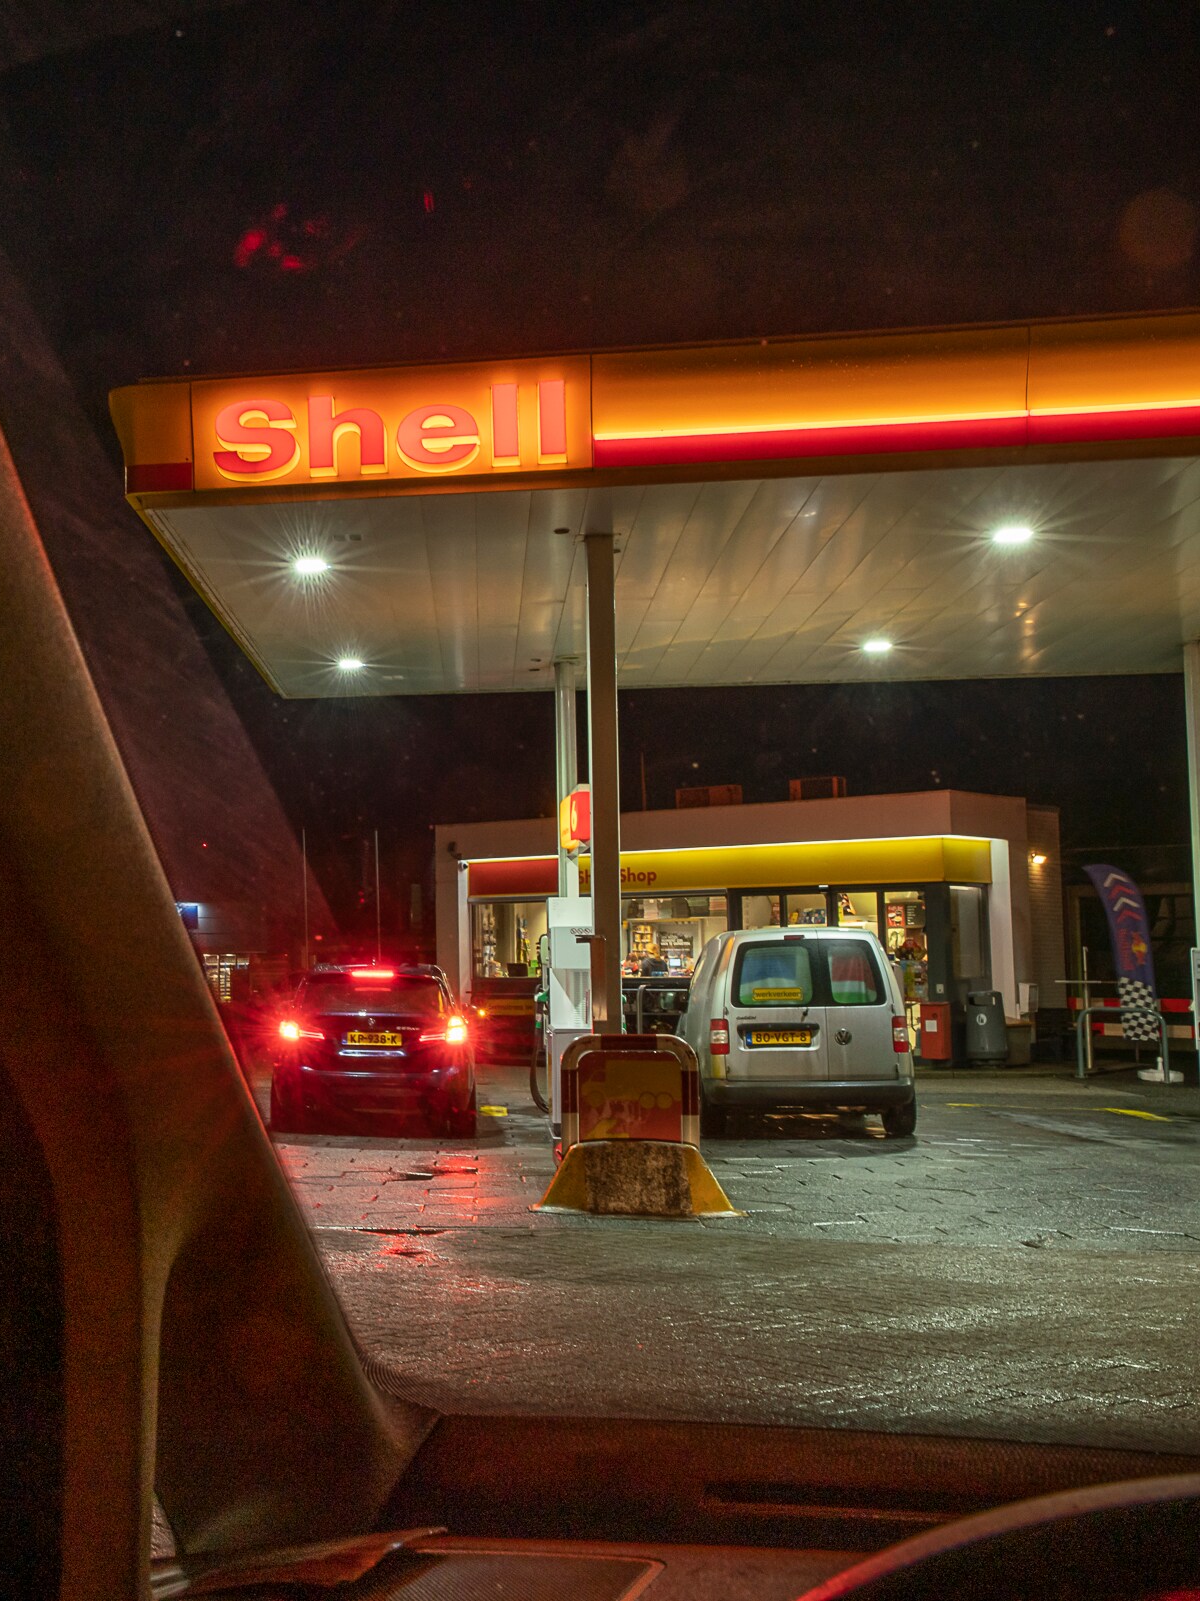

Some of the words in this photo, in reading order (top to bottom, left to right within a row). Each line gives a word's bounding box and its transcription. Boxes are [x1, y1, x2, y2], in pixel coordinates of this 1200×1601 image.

[213, 379, 569, 482] Shell
[570, 800, 578, 833] 6
[620, 868, 657, 886] Shop
[755, 990, 799, 999] werkverkeer
